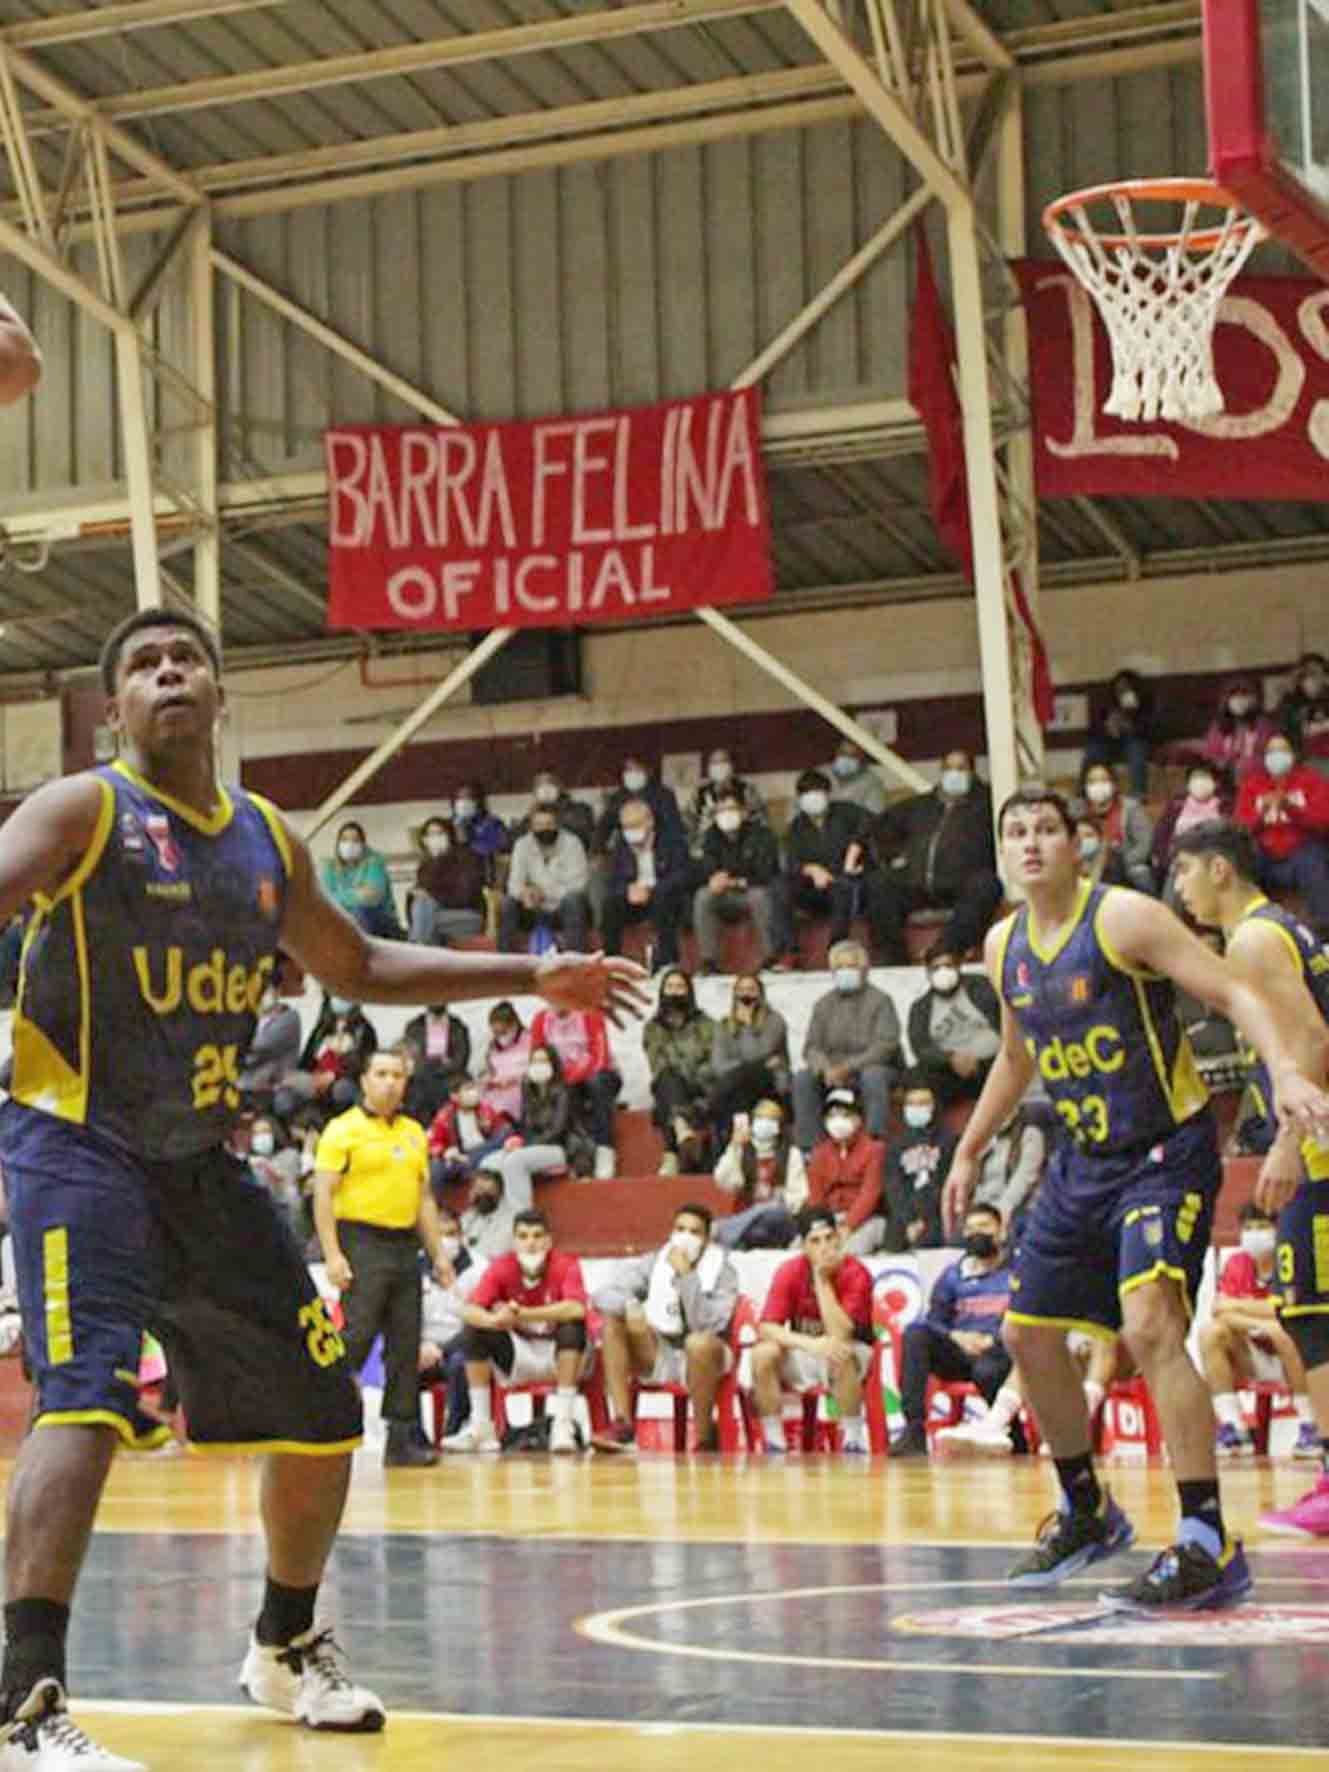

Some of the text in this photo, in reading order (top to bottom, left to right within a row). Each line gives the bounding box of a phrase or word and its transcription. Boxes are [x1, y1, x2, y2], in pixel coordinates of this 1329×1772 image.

[325, 395, 760, 549] BARRA FELINA
[385, 545, 671, 620] OFICIAL
[1025, 1024, 1126, 1081] deC
